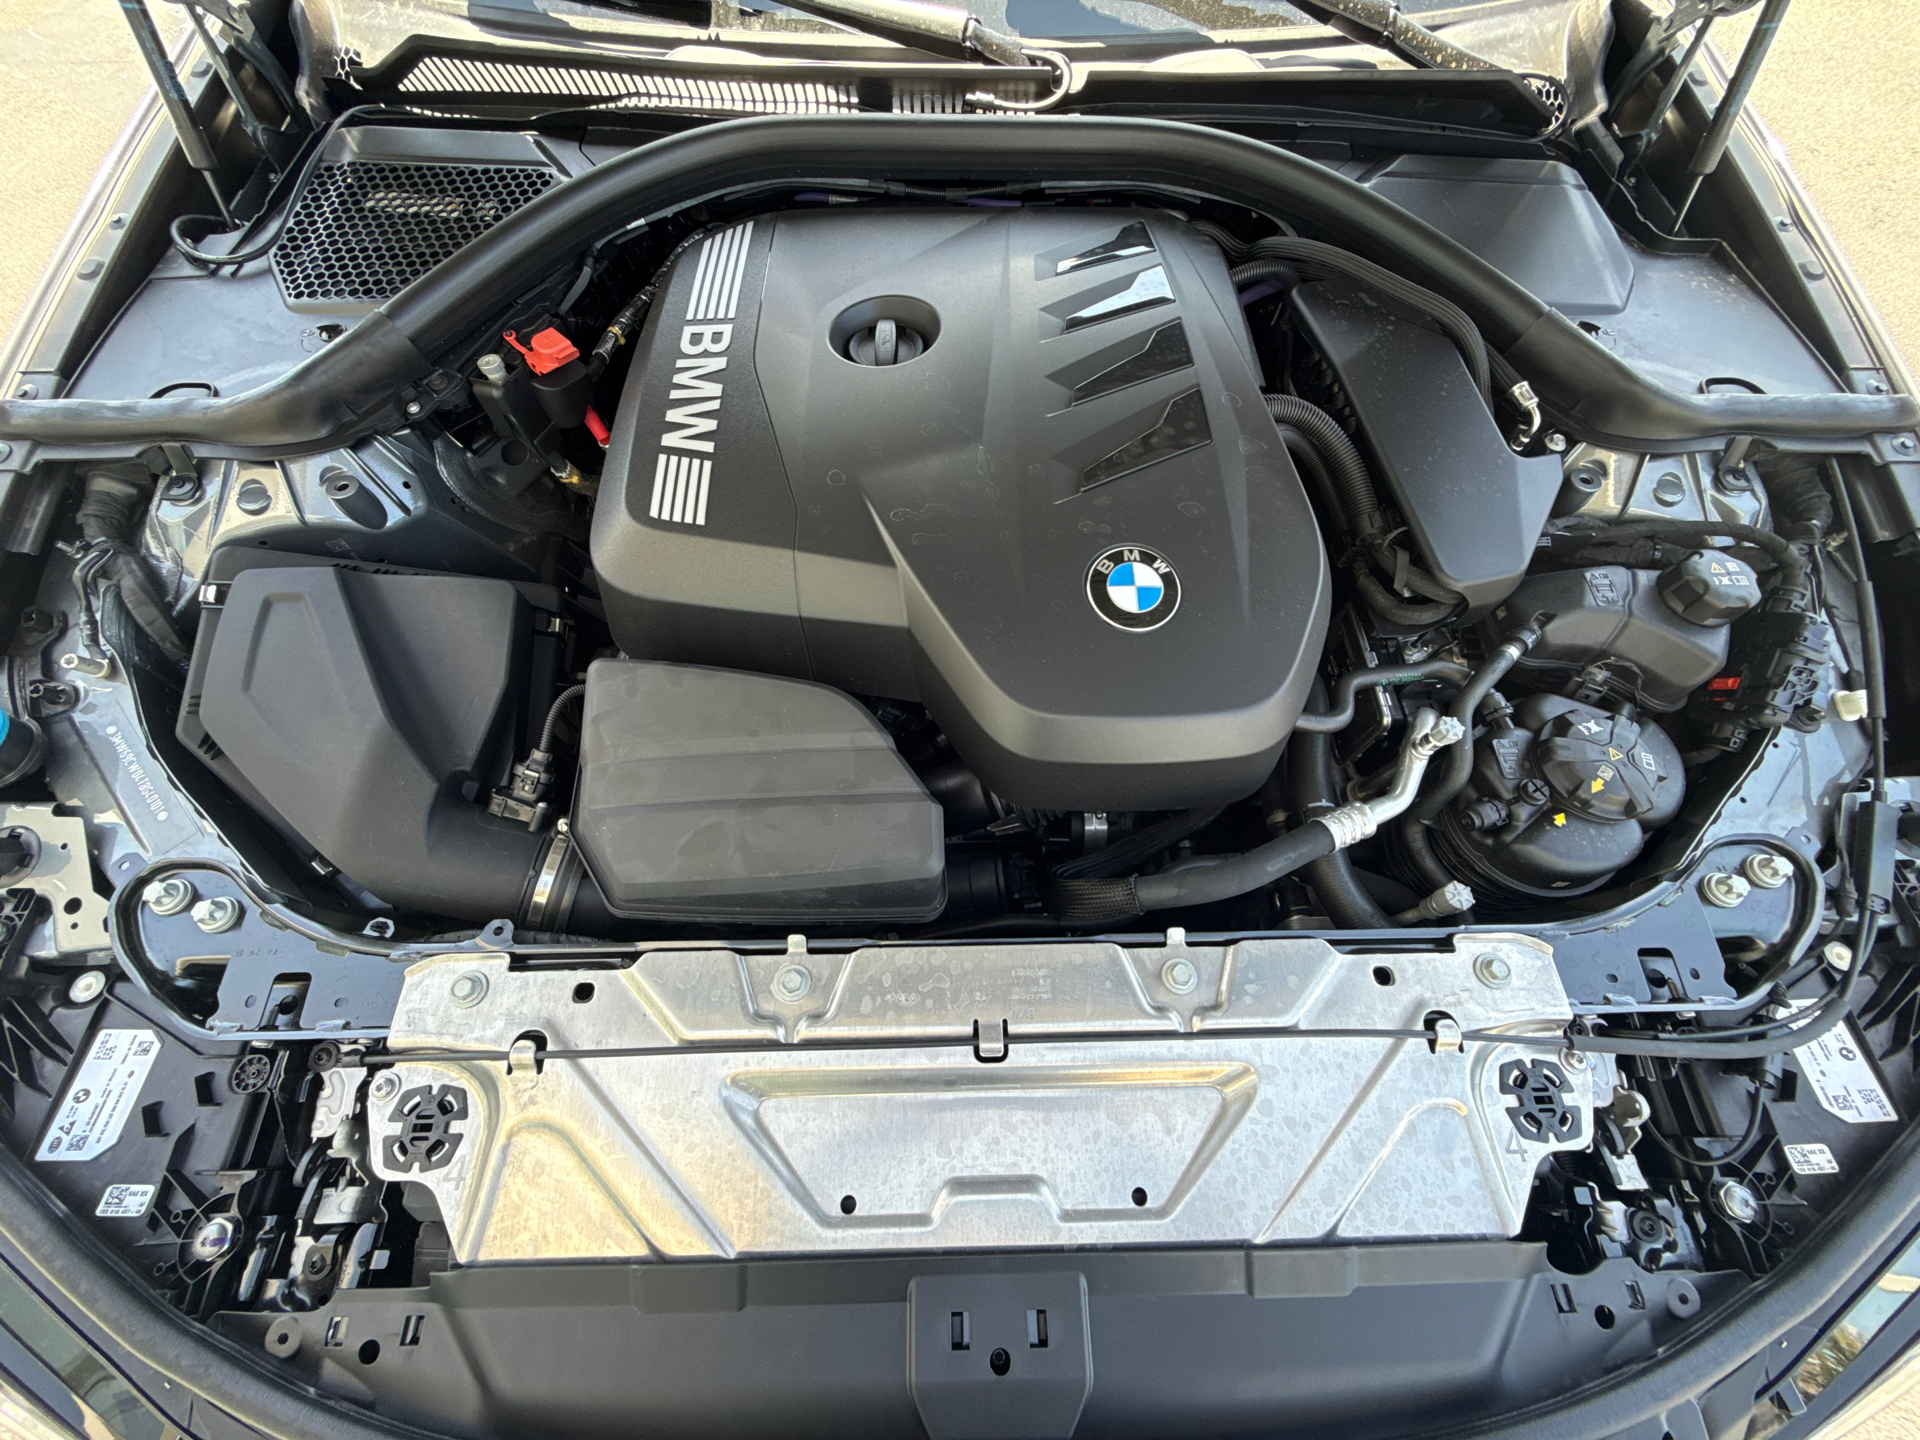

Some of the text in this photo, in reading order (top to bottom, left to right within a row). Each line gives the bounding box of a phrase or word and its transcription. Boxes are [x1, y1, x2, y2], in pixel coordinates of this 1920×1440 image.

[661, 324, 733, 453] BMW
[1096, 549, 1170, 575] BMW
[1505, 1127, 1528, 1162] 4
